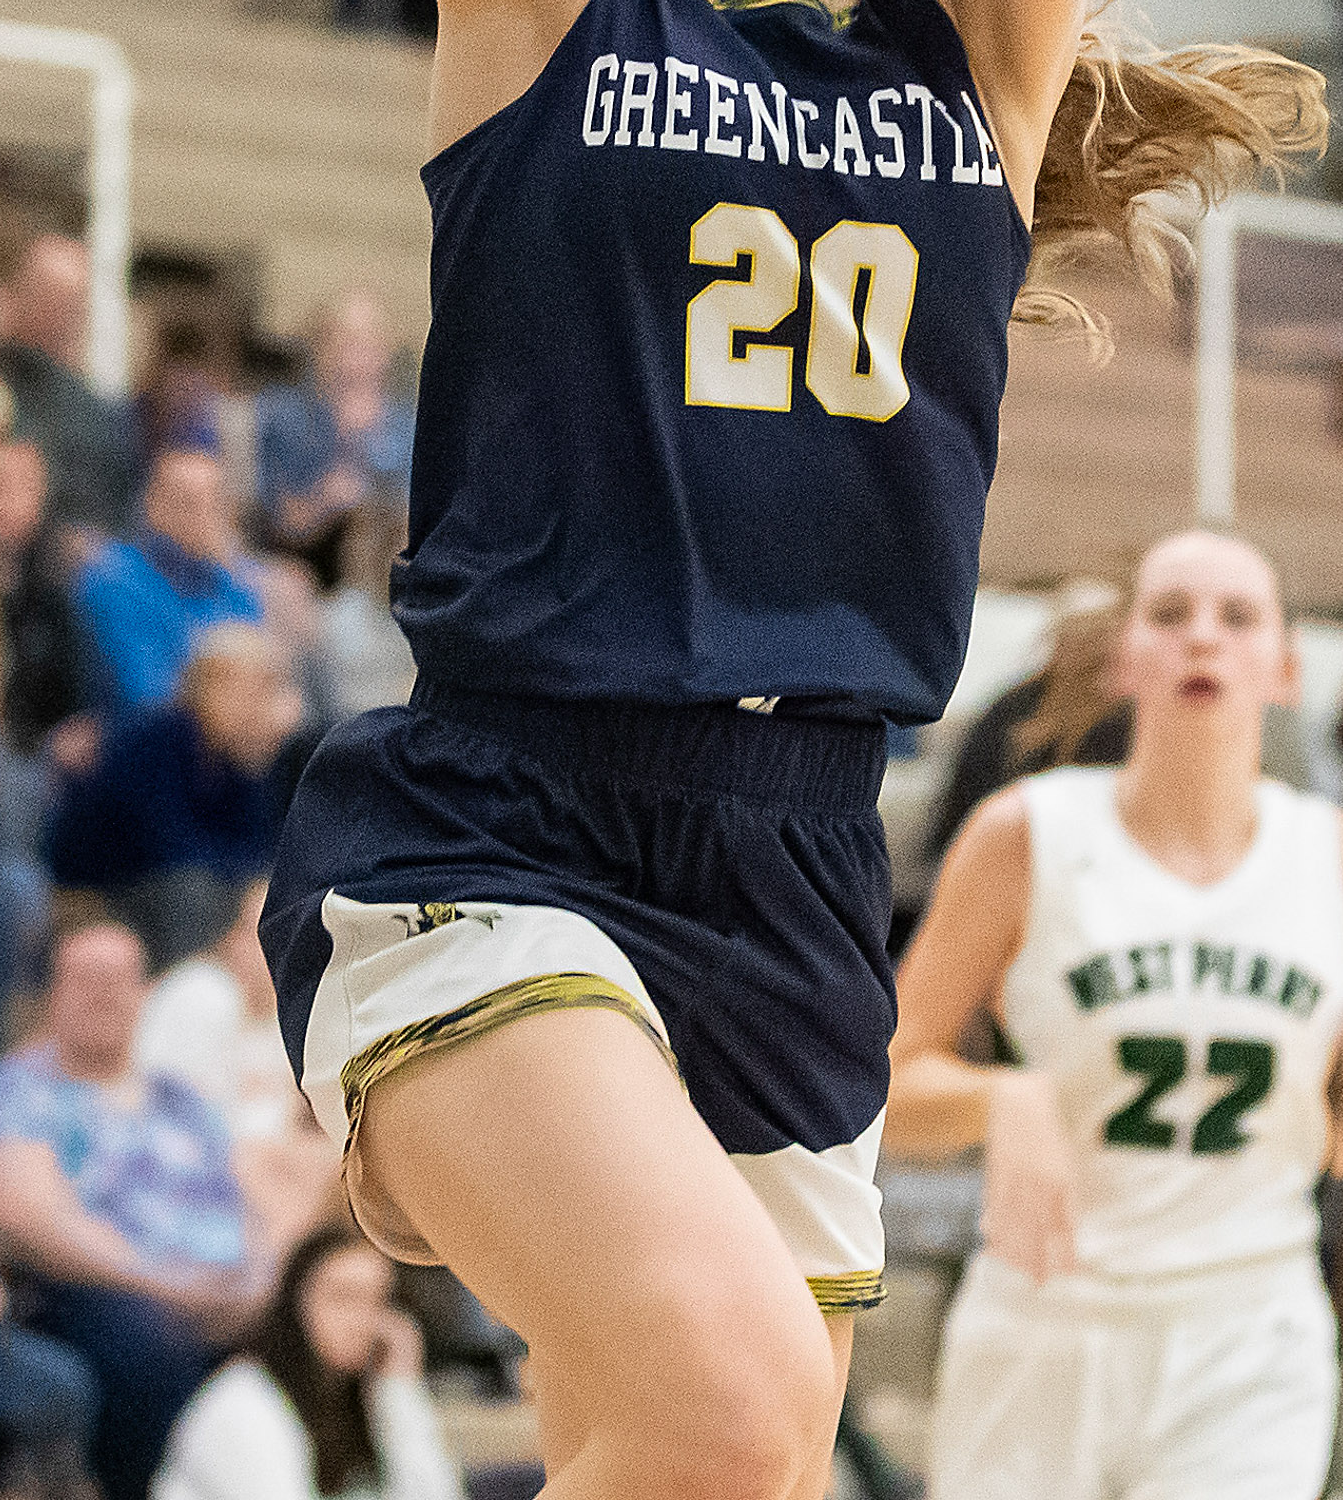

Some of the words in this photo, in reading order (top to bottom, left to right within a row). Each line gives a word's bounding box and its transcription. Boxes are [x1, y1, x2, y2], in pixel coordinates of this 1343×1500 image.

[581, 53, 1004, 187] GREENCASTLE
[685, 202, 920, 422] 20
[1103, 1034, 1275, 1155] 22
